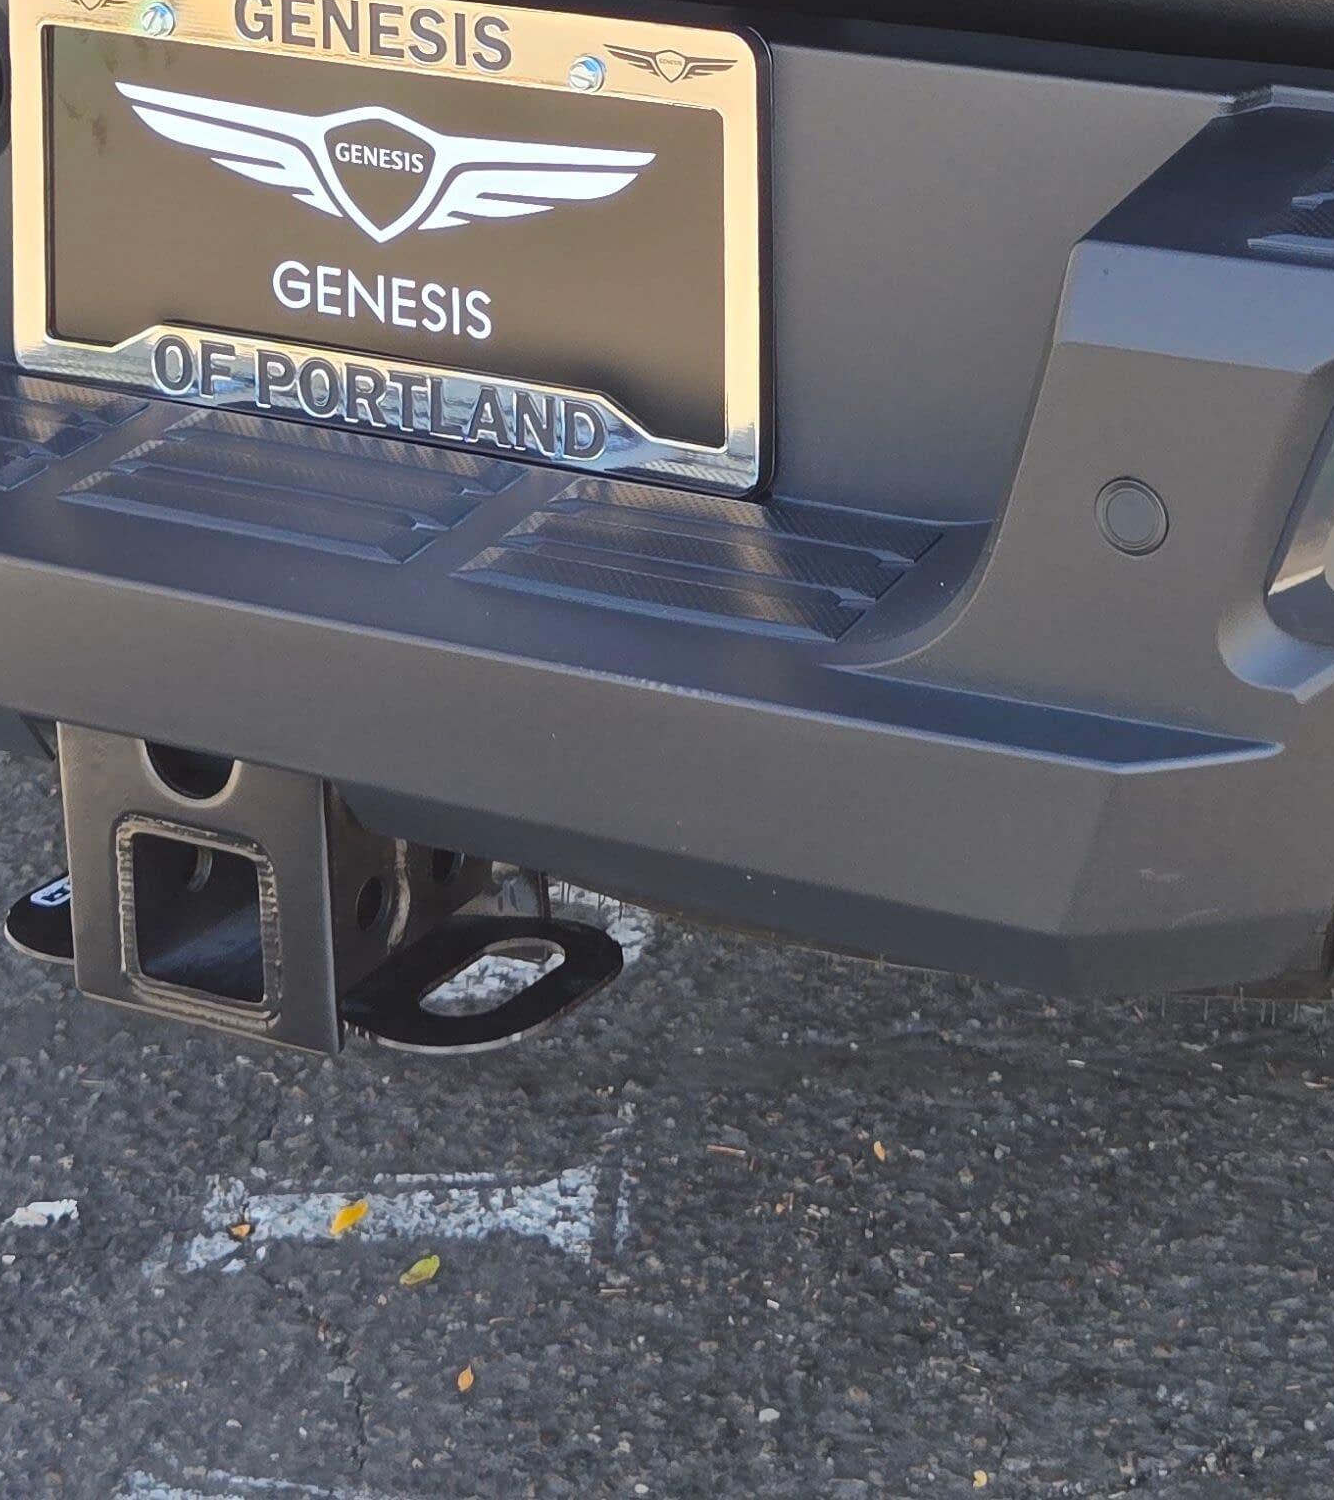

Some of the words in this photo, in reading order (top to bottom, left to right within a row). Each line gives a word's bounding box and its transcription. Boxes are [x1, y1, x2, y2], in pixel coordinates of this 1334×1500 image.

[335, 142, 424, 174] GENESIS
[273, 260, 492, 339] GENESIS
[153, 334, 236, 397] OF
[256, 351, 609, 461] PORTLAND
